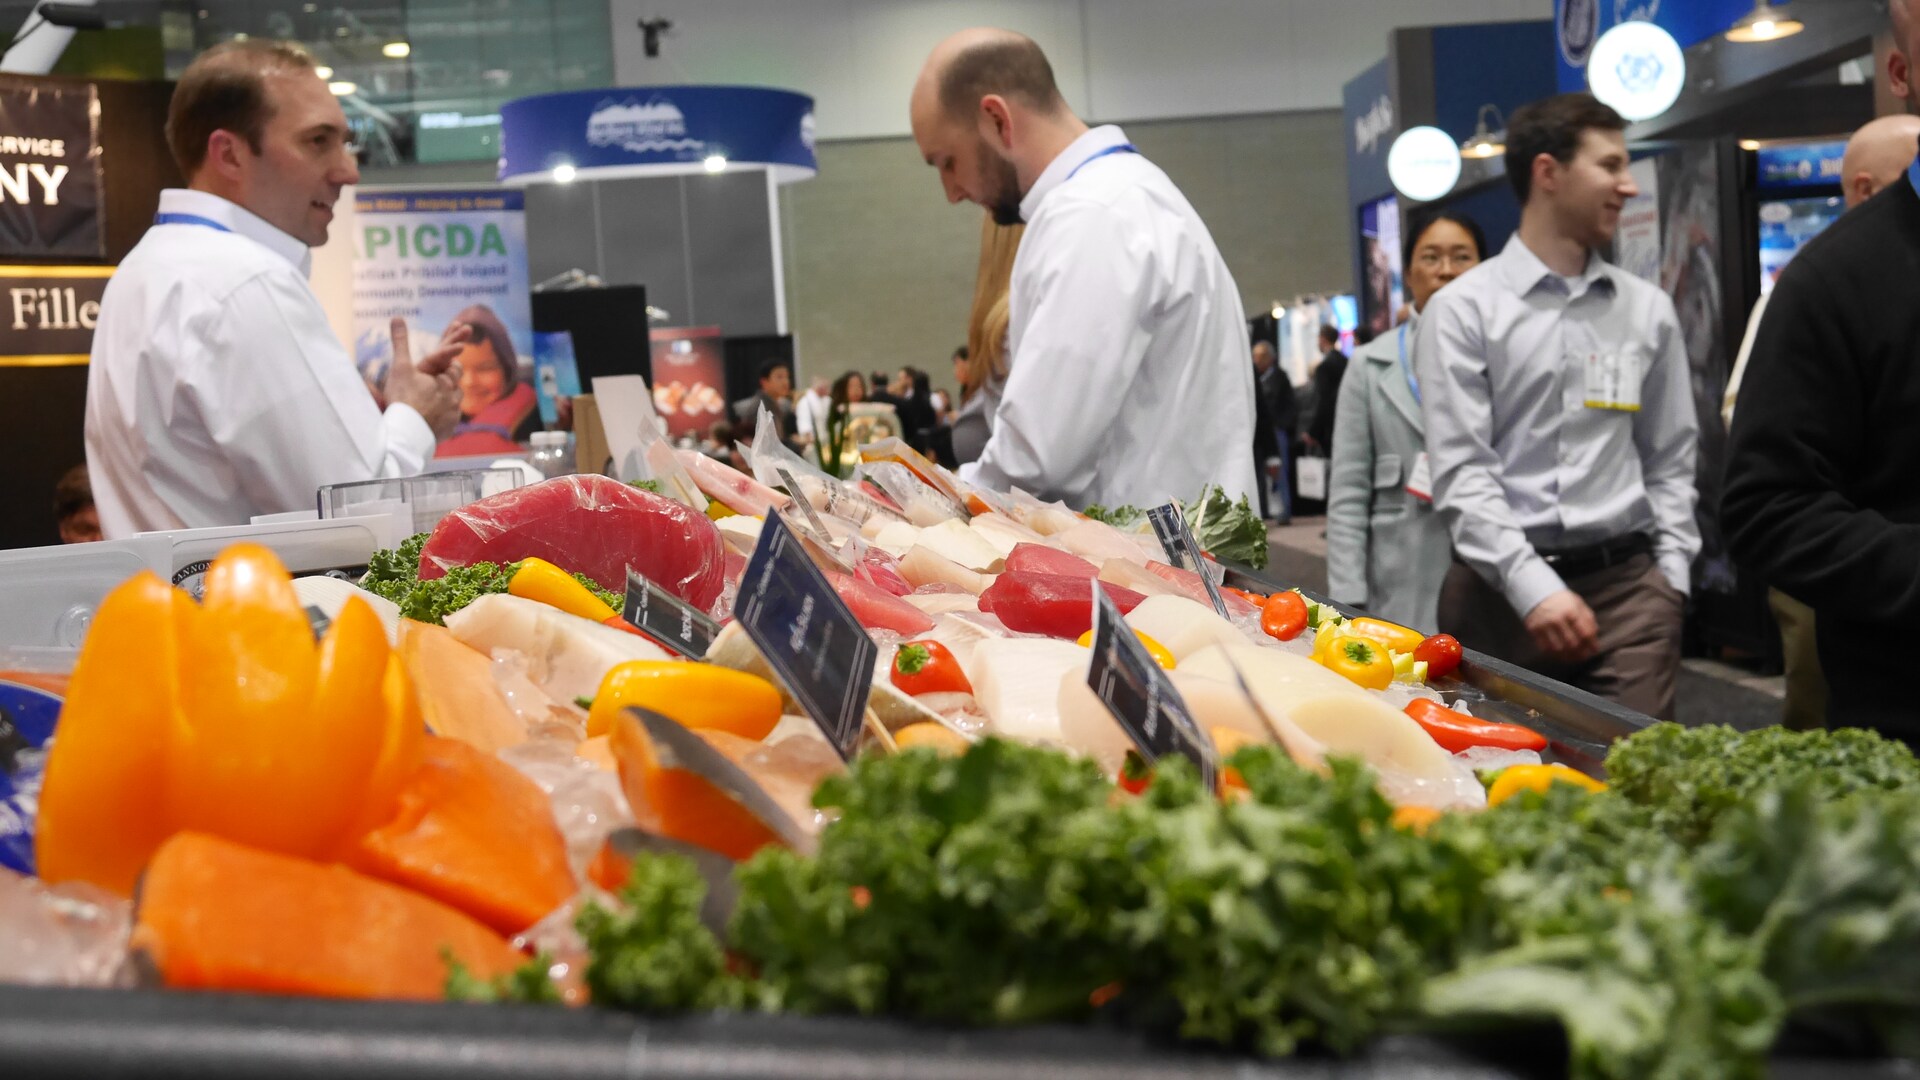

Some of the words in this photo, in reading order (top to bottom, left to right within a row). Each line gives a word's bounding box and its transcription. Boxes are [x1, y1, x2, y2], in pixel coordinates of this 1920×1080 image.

[0, 136, 65, 157] RVICE
[0, 163, 69, 205] NY
[352, 223, 508, 259] PICDA
[10, 287, 100, 329] Fille
